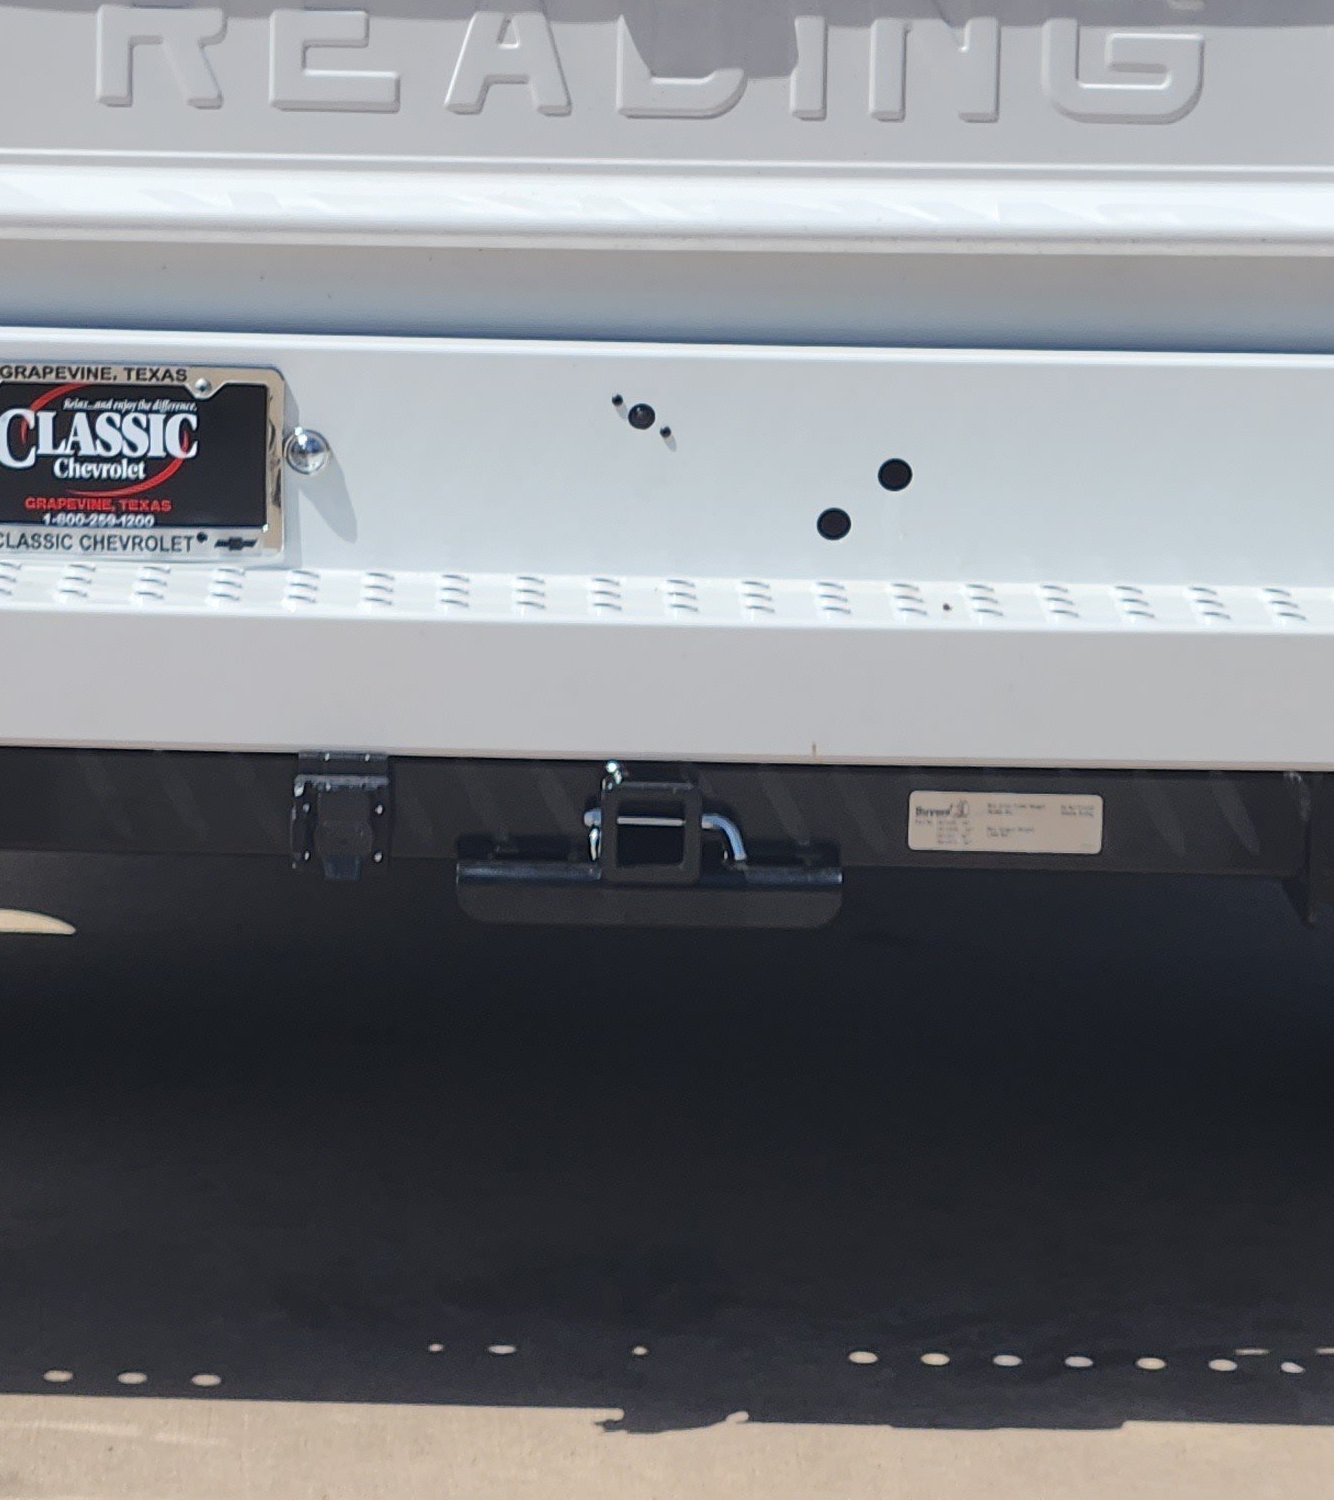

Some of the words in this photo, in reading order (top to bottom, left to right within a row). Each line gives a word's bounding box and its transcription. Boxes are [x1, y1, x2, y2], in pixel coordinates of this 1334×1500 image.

[0, 365, 117, 382] GRAPEVINE,
[123, 367, 188, 382] TEXAS
[53, 457, 147, 480] Chevrolet
[25, 496, 115, 512] GRAPEVINE,
[119, 499, 172, 513] TEXAS
[79, 533, 195, 552] CHEVROLET
